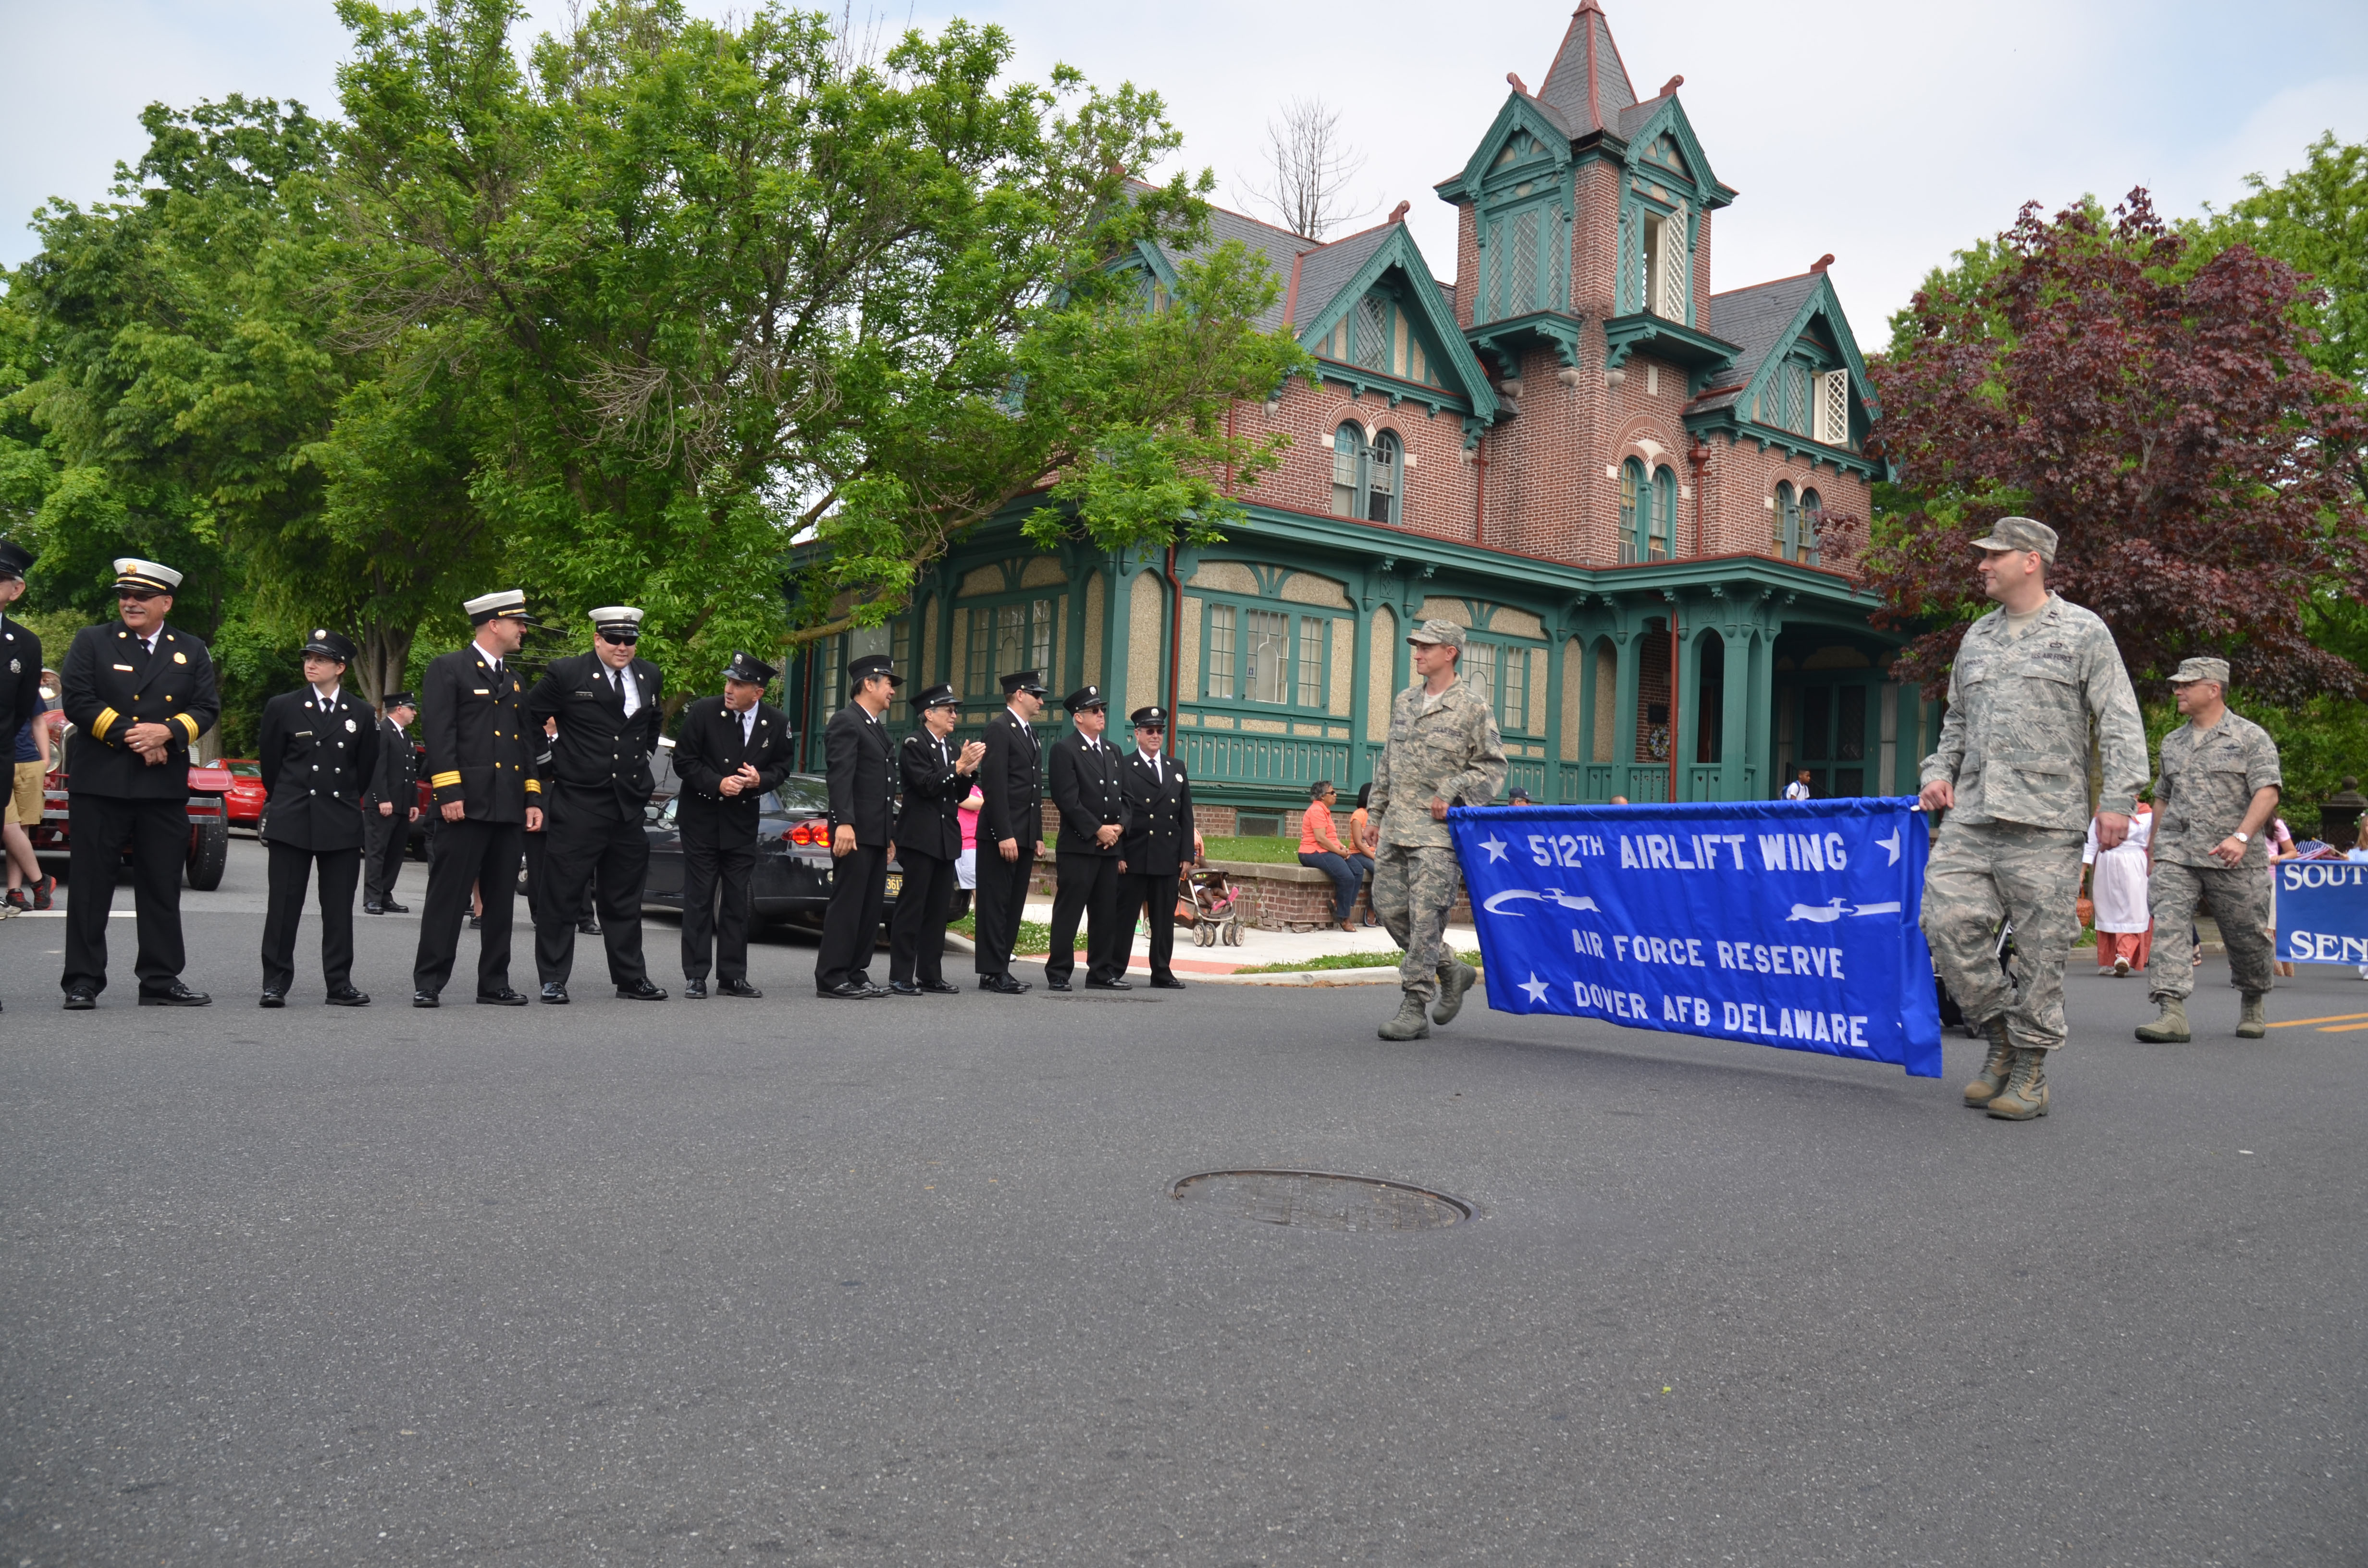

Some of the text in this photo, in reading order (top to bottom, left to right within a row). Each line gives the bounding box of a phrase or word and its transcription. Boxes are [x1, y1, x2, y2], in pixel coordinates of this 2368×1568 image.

[2053, 653, 2072, 663] FORCE
[1527, 832, 1847, 872] 512TH AIRLIFT WING
[2283, 864, 2368, 891] SOUT
[1572, 929, 1845, 980] AIR FORCE RESERVE
[2289, 931, 2368, 962] SEN
[1573, 981, 1869, 1047] DOVER AFB DELAWARE
